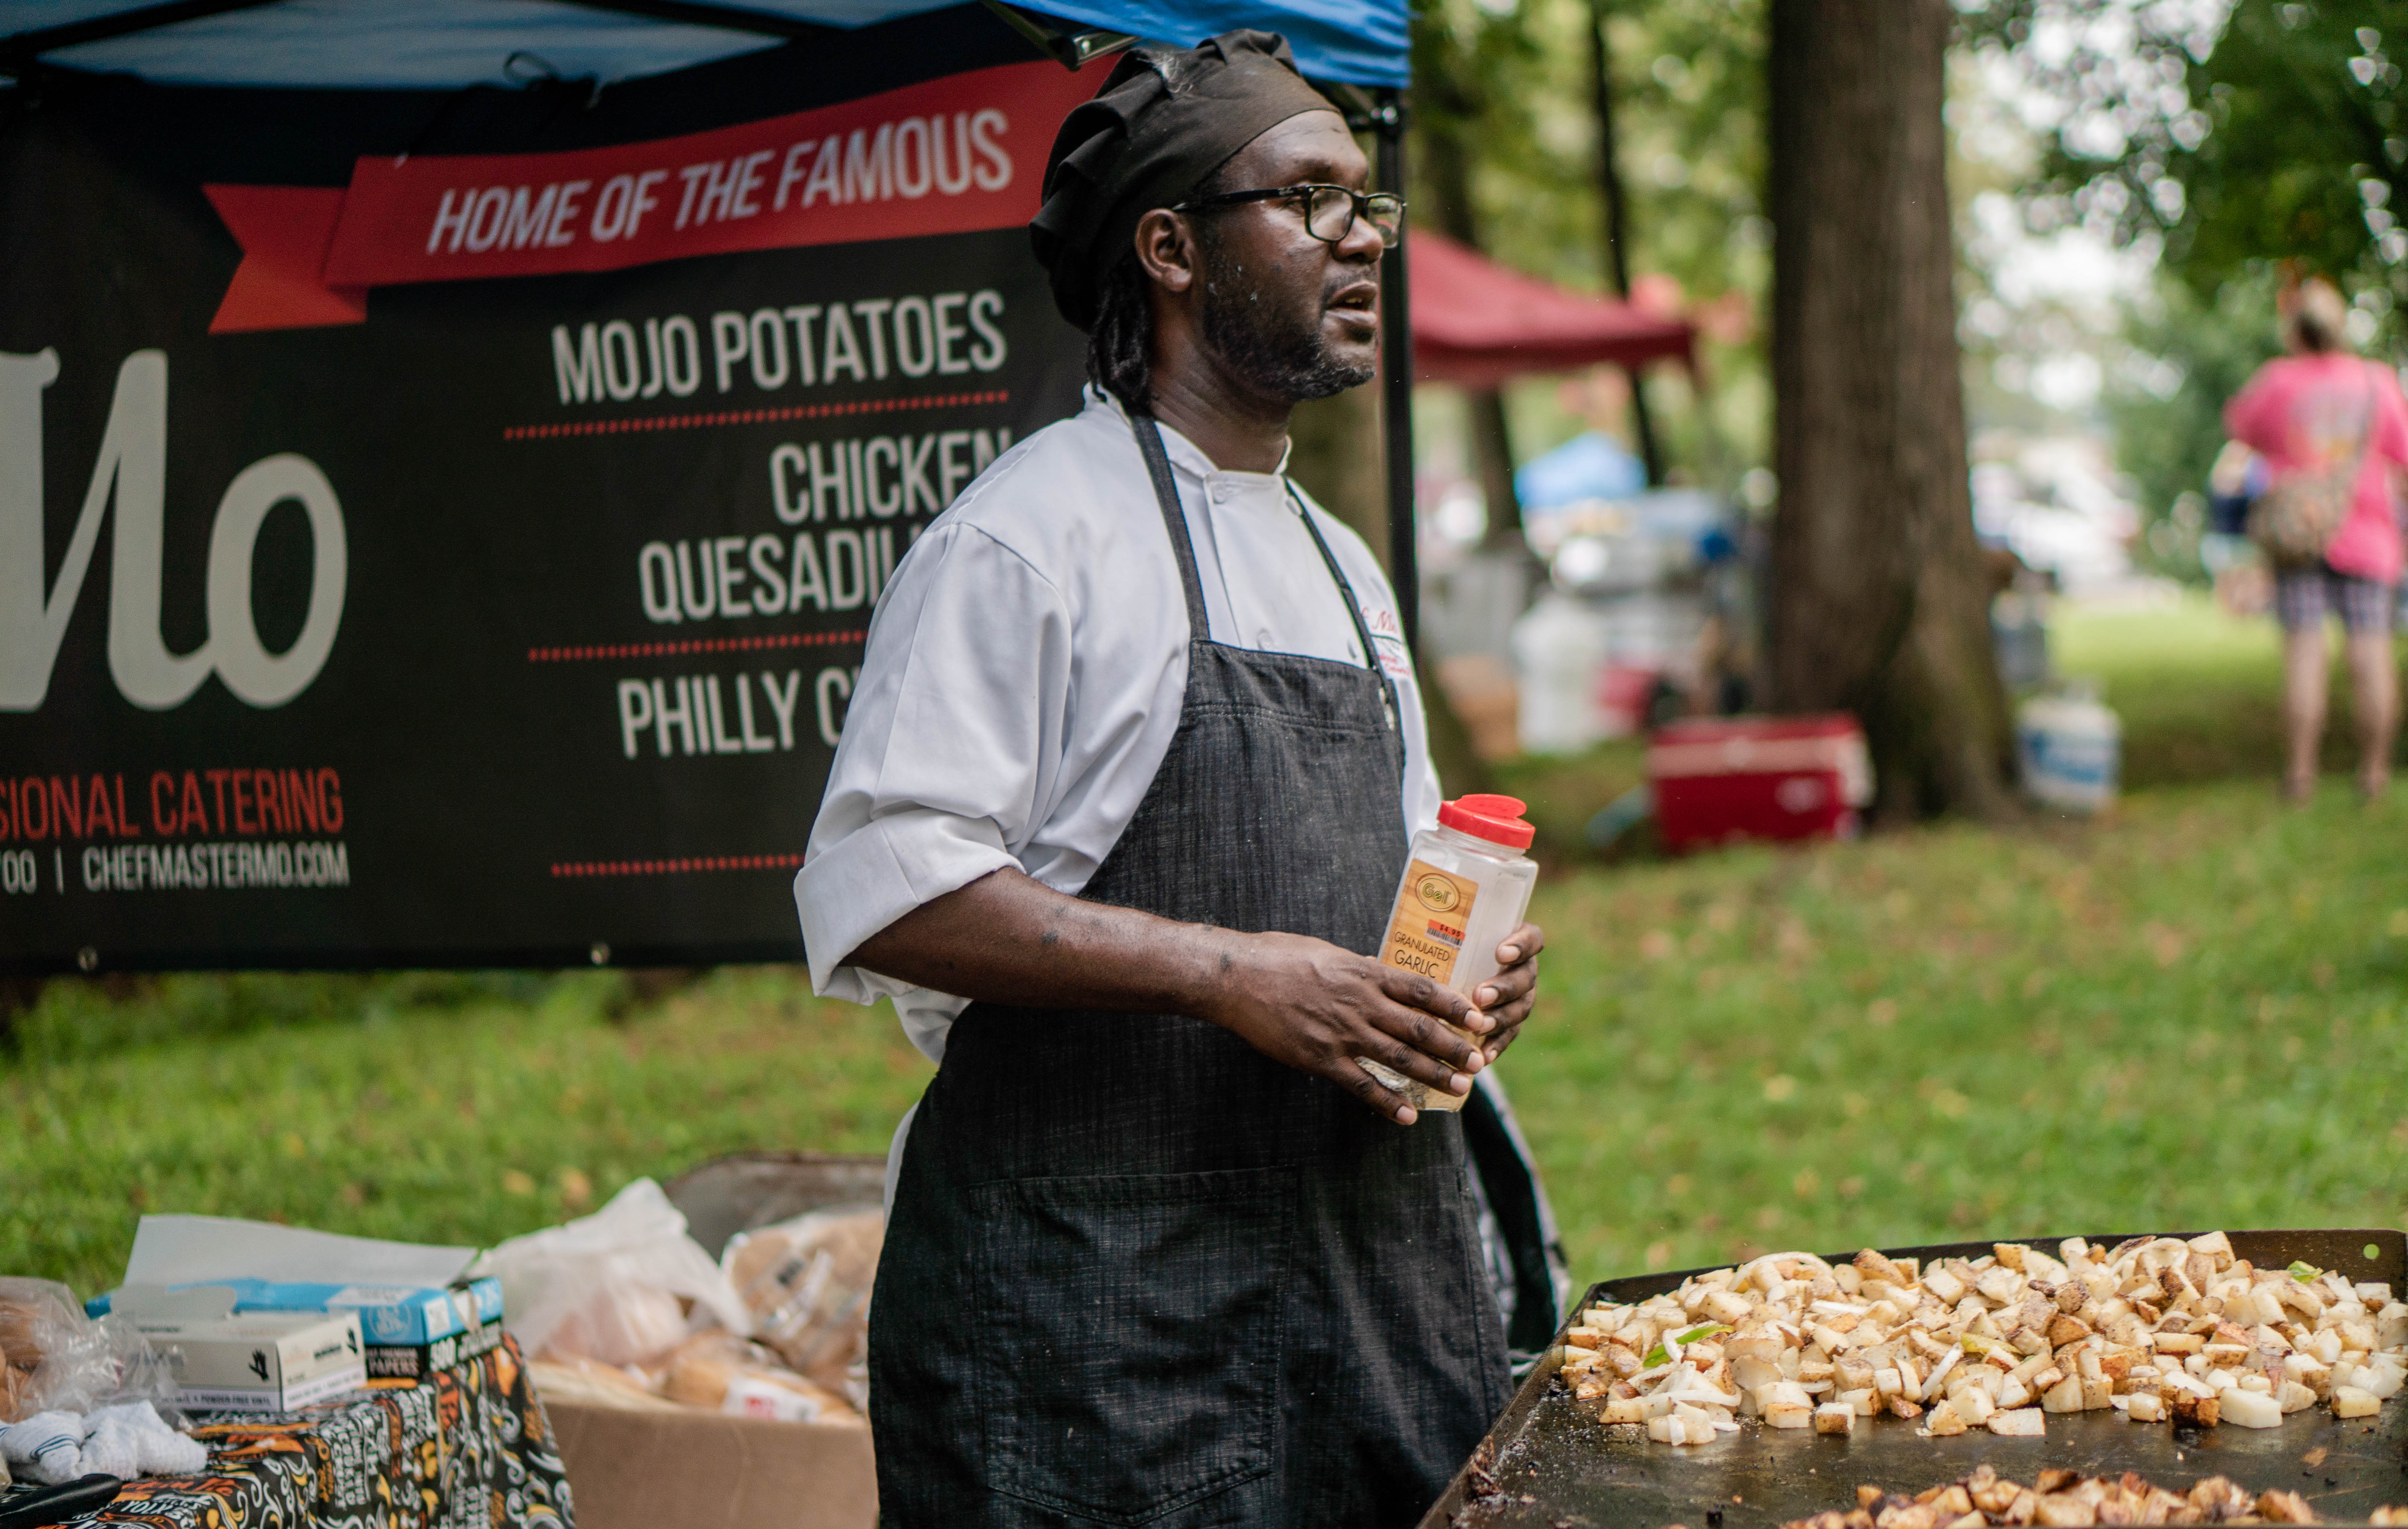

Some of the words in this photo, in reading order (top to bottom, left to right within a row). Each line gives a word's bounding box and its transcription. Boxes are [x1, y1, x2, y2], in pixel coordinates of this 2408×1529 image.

[426, 179, 593, 256] HOME
[590, 168, 669, 243] OF
[673, 148, 776, 231] THE
[772, 108, 1013, 213] FAMOUS
[551, 314, 702, 405] MOJO
[711, 288, 1009, 395] POTATOES
[617, 667, 802, 760] PHILLY
[149, 767, 345, 837] CATERING
[82, 840, 351, 892] CHEFMASTERMO.COM
[1394, 931, 1450, 961] GRANULATED
[1440, 924, 1461, 937] $4.95
[1394, 949, 1439, 979] GARLIC
